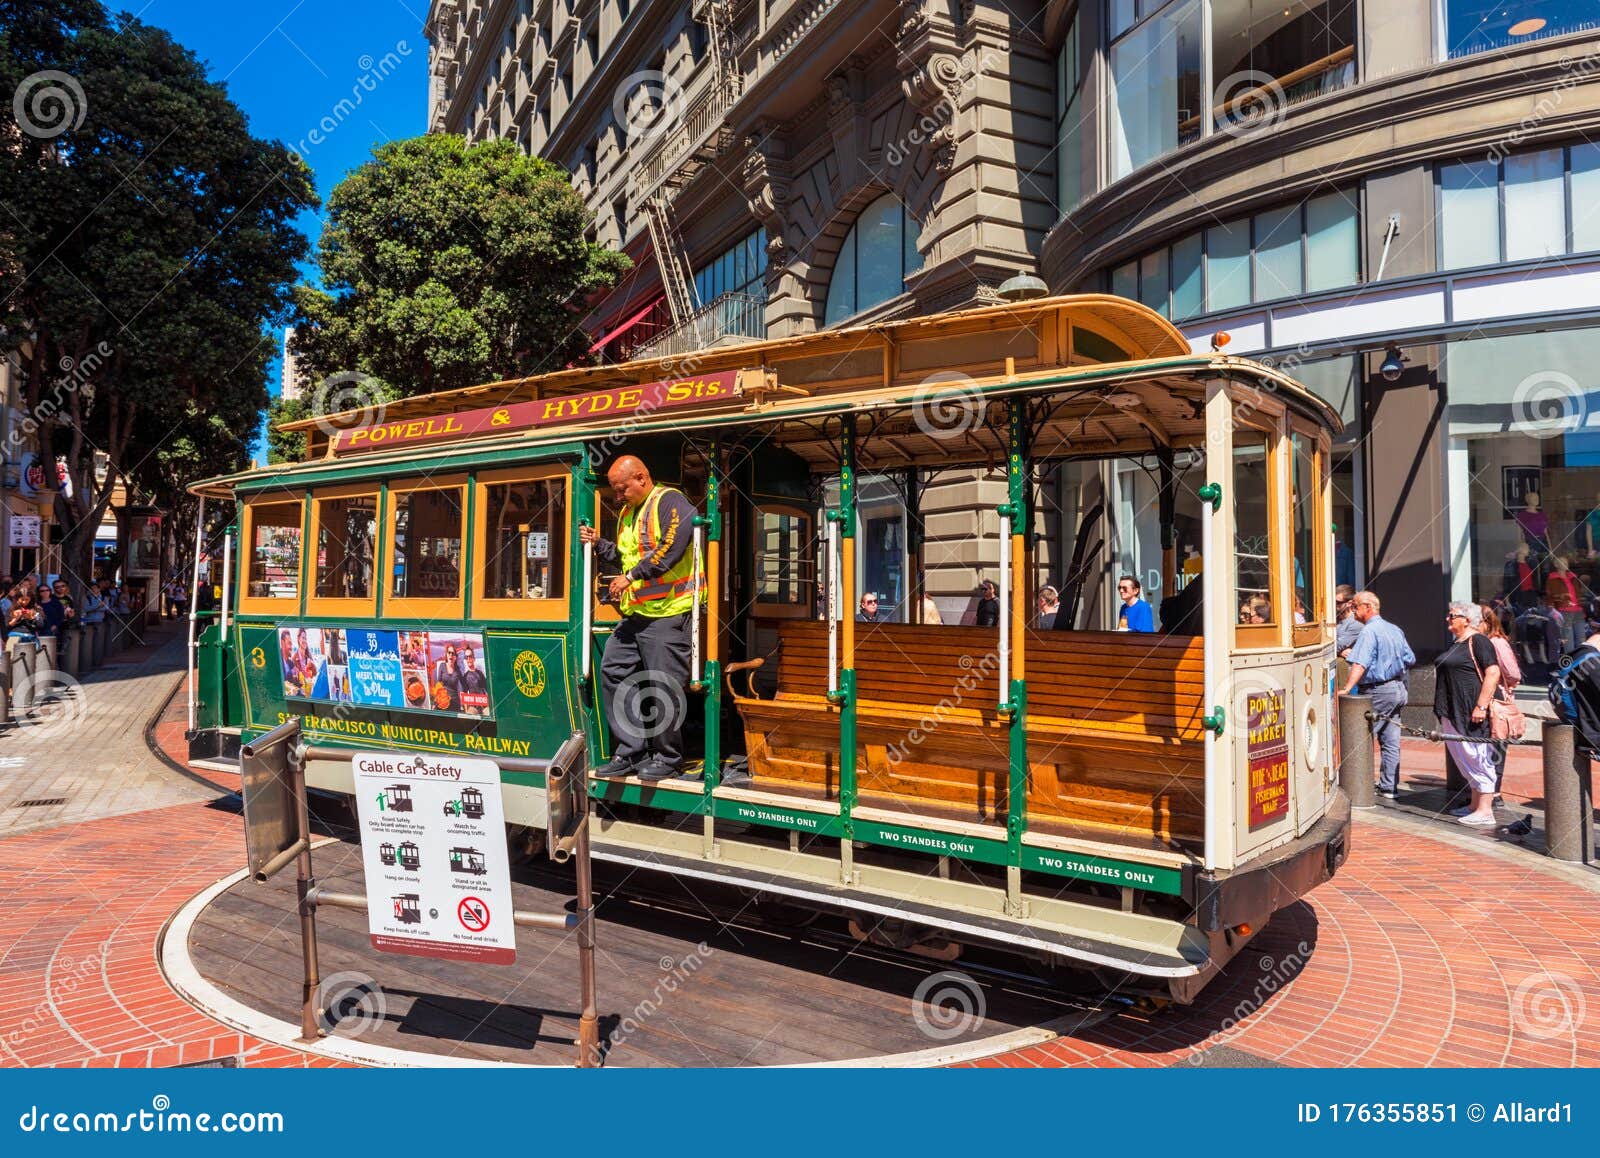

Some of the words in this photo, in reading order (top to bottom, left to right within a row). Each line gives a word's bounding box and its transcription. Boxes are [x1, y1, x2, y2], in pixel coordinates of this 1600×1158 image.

[349, 418, 463, 445] POWELL
[491, 409, 511, 426] &
[541, 389, 643, 419] HYDE
[666, 381, 727, 401] Sts.
[367, 639, 378, 652] 39
[251, 647, 266, 667] 3
[1304, 663, 1313, 695] 3
[1250, 695, 1285, 715] POWELL
[1260, 712, 1278, 726] AND
[305, 715, 376, 736] FRANCISCO
[381, 724, 459, 747] MUNICIPAL
[465, 735, 531, 756] RAILWAY
[1249, 724, 1285, 745] MARKET
[359, 760, 393, 773] Cable
[397, 762, 417, 775] Car
[421, 763, 461, 781] Safety
[739, 808, 756, 818] TWO
[757, 811, 794, 824] STANDEES
[797, 817, 817, 828] ONLY
[879, 831, 899, 841] TWO
[902, 834, 946, 849] STANDEES
[949, 842, 974, 853] ONLY
[1038, 856, 1063, 868] TWO
[1066, 861, 1120, 878] STANDEES
[1124, 871, 1155, 884] ONLY
